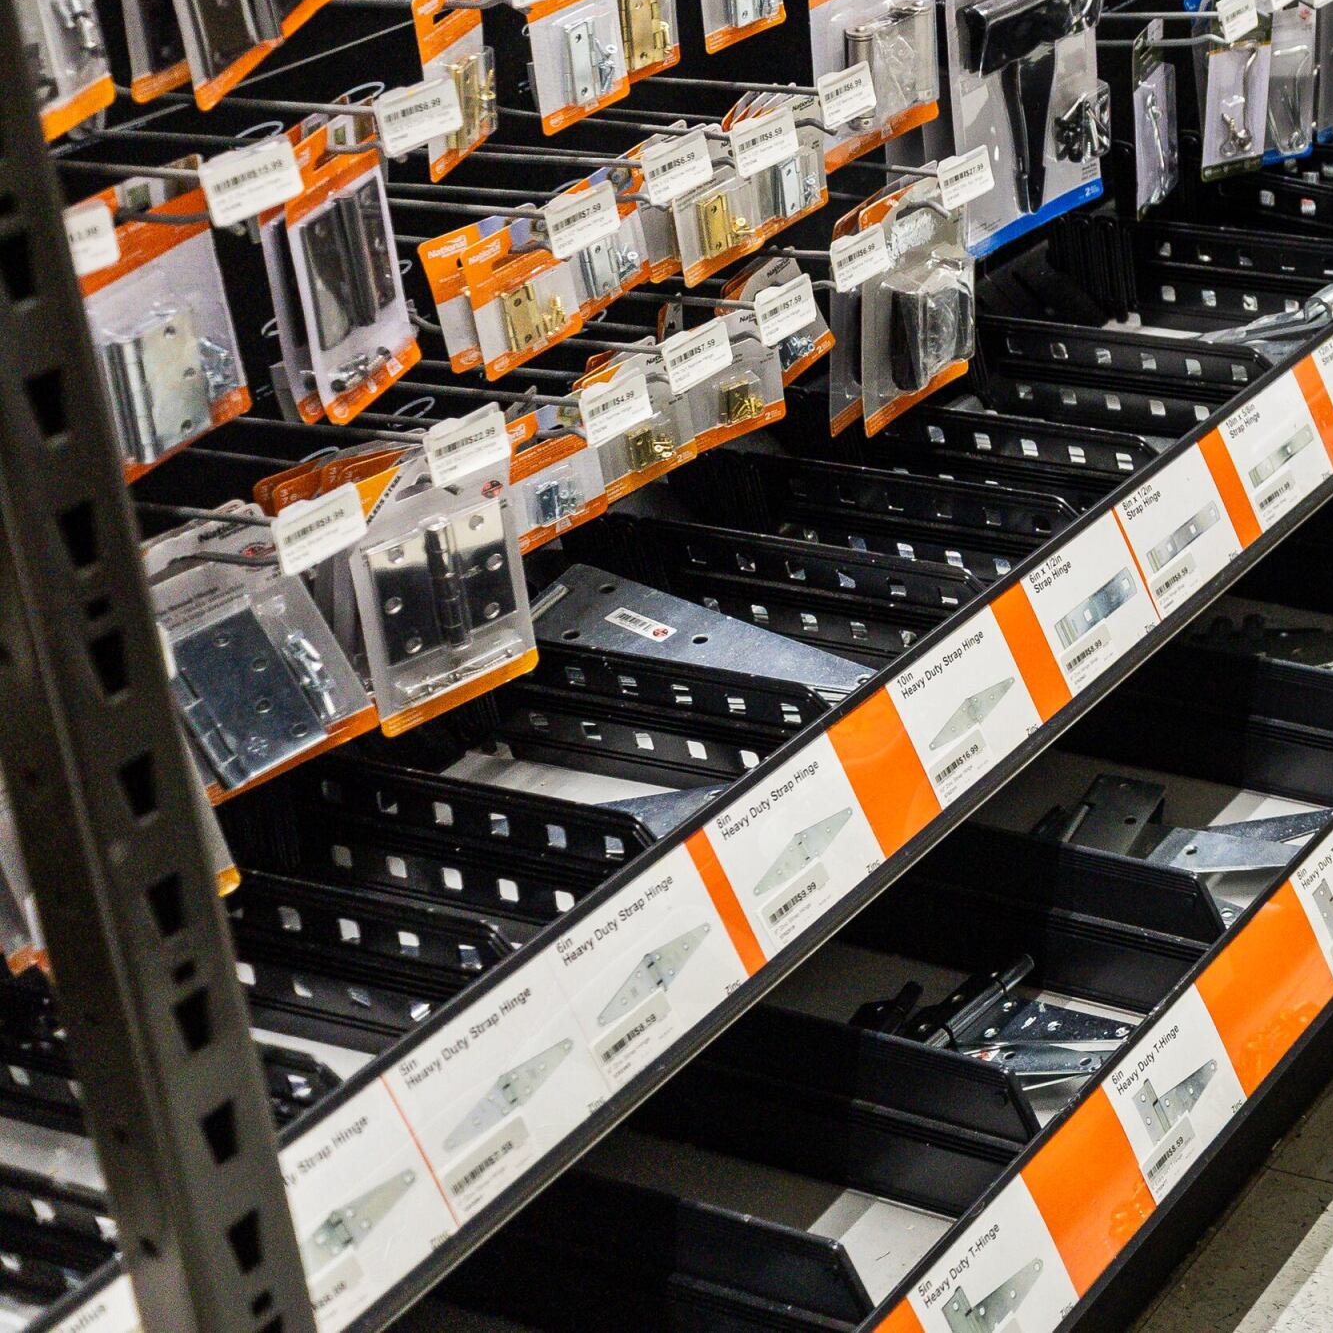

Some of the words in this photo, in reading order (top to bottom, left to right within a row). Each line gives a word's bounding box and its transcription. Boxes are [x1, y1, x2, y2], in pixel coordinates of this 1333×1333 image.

[763, 127, 783, 141] $8.59
[675, 151, 695, 166] $6.59
[965, 163, 985, 178] $27.99
[581, 202, 601, 218] $7.59
[857, 242, 876, 256] $6.99
[784, 294, 802, 309] $7.59
[696, 339, 716, 354] $7.59
[614, 390, 635, 405] $4.99
[1229, 423, 1246, 439] Strap
[1245, 411, 1261, 428] Hinge
[1123, 498, 1135, 511] 8in
[1138, 483, 1153, 499] 1/2in
[1126, 503, 1145, 521] Strap
[1144, 489, 1162, 508] Hinge
[1029, 569, 1043, 584] 6in
[1046, 553, 1063, 572] 1/2in
[1034, 575, 1053, 595] Strap
[1052, 560, 1072, 581] Hinge
[1086, 638, 1102, 654] $8.99
[901, 675, 926, 700] Heavy
[924, 662, 943, 683] Duty
[942, 645, 963, 668] Strap
[961, 628, 985, 654] Hinge
[896, 671, 915, 689] 10in
[956, 743, 979, 764] $16.99
[720, 814, 750, 842] Heavy
[748, 797, 771, 820] Duty
[770, 779, 795, 805] Strap
[793, 758, 820, 786] Hinge
[715, 812, 732, 830] 8in
[865, 857, 881, 875] Zinc
[1296, 865, 1308, 882] 8in
[1301, 864, 1320, 892] Heavy
[797, 881, 817, 903] $9.99
[561, 939, 594, 968] Heavy
[593, 918, 619, 944] Duty
[617, 897, 646, 927] Strap
[643, 874, 675, 905] Hinge
[556, 935, 574, 955] 6in
[405, 1060, 440, 1092] Heavy
[440, 1034, 470, 1065] Duty
[467, 1012, 500, 1047] Strap
[499, 984, 532, 1019] Hinge
[1115, 1069, 1139, 1096] Heavy
[1139, 1049, 1159, 1073] Duty
[1154, 1022, 1181, 1054] T-Hinge
[1110, 1067, 1126, 1086] 6in
[1231, 1097, 1245, 1114] Zinc
[299, 1134, 331, 1175] Strap
[331, 1113, 370, 1156] Hinge
[1166, 1134, 1185, 1159] $8.59
[922, 1277, 949, 1310] Heavy
[948, 1254, 970, 1280] Duty
[968, 1221, 1002, 1257] T-Hinge
[918, 1278, 933, 1298] 5in
[1059, 1298, 1075, 1320] Zinc
